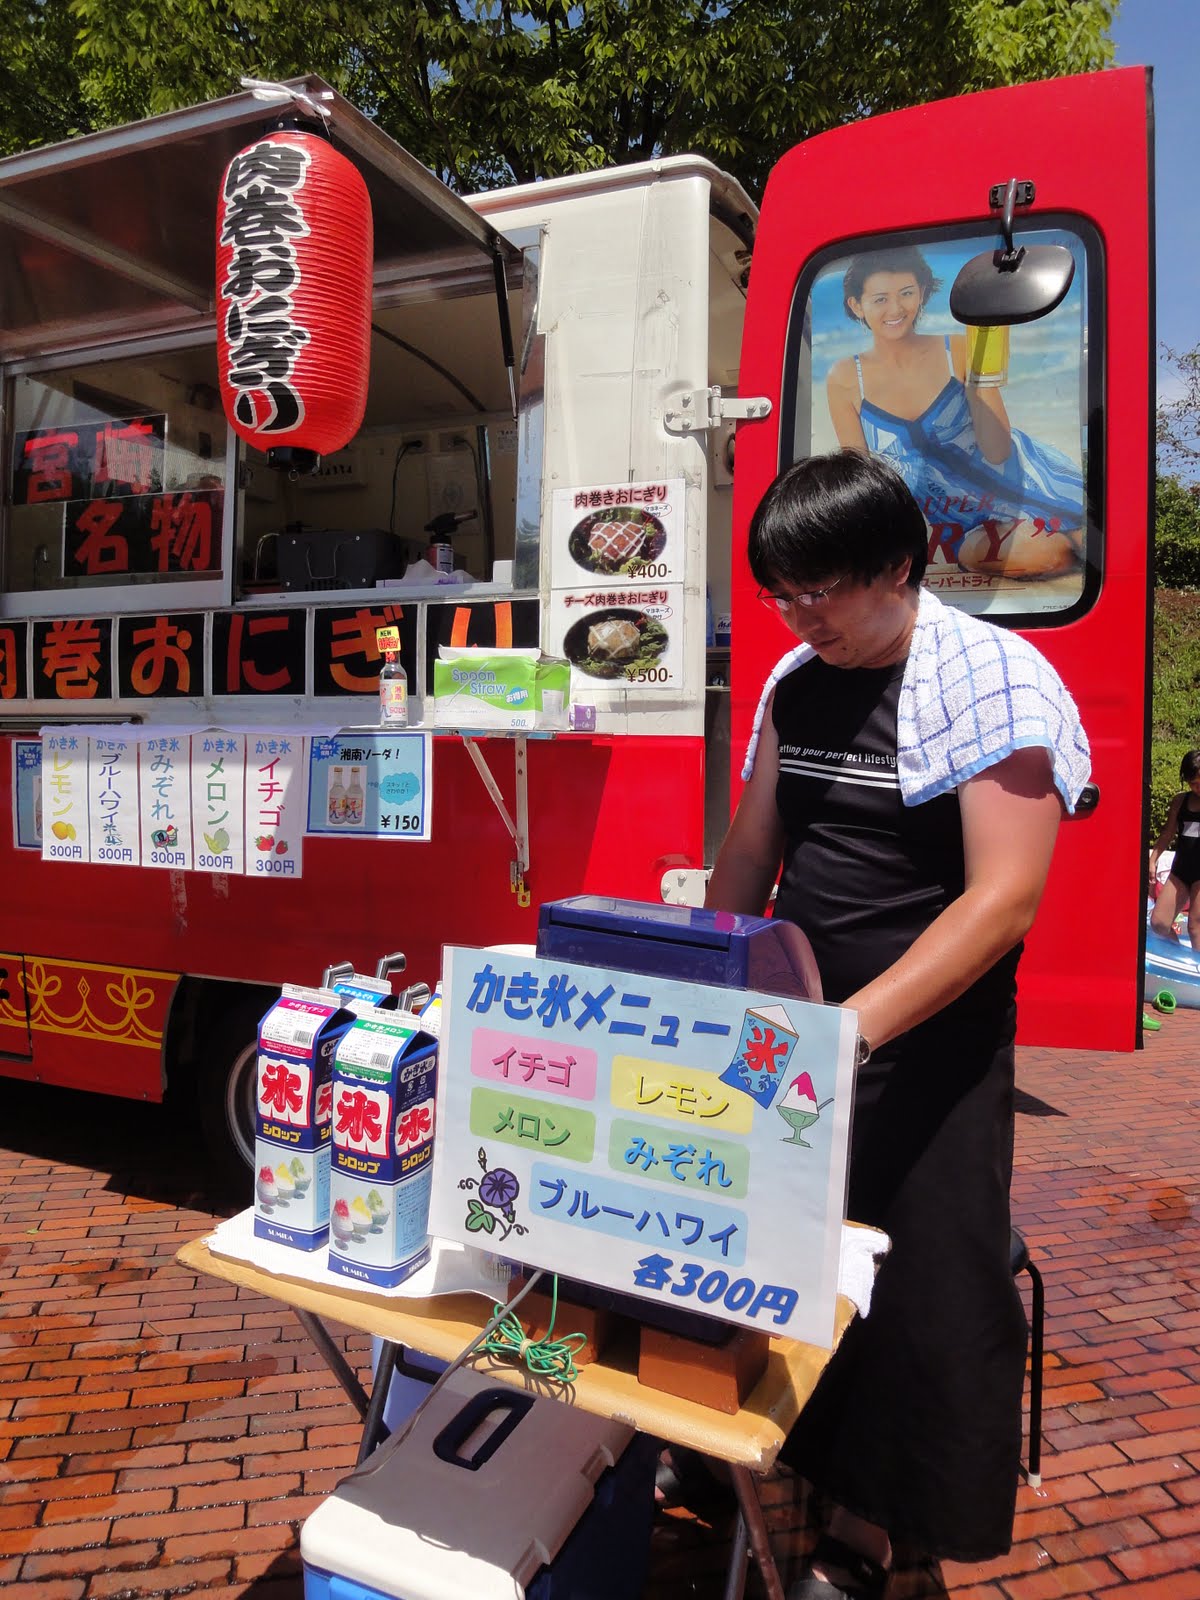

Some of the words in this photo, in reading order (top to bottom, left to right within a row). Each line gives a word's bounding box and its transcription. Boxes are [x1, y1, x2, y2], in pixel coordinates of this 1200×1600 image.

[221, 142, 311, 433] 肉巻おにぎり
[575, 486, 668, 507] 肉巻きおにぎり
[916, 491, 998, 515] UPER
[75, 493, 212, 574] 名物
[565, 590, 668, 608] チーズ肉巻きおにぎり
[453, 669, 495, 683] Spoon
[471, 682, 506, 695] Straw
[49, 737, 78, 750] かき氷
[148, 738, 179, 752] かき氷
[203, 738, 238, 752] かき氷
[256, 740, 291, 754] かき氷
[803, 748, 825, 756] your
[825, 751, 862, 763] perfect
[864, 753, 899, 768] lifesty
[50, 752, 73, 816] レモン
[99, 753, 121, 823] ブルーハワイ
[151, 754, 174, 820] みぞれ
[206, 757, 229, 825] メロン
[258, 757, 285, 827] イチゴ
[50, 845, 82, 858] 300円
[98, 848, 132, 861] 300円
[151, 851, 185, 865] 300円
[199, 855, 233, 869] 300円
[256, 859, 294, 874] 300円
[466, 964, 731, 1047] かき氷メニュー
[742, 1026, 788, 1073] 氷
[491, 1047, 576, 1087] イチゴ
[260, 1064, 303, 1113] 氷
[635, 1076, 730, 1117] レモン
[335, 1090, 382, 1143] 氷
[398, 1107, 431, 1146] 氷
[493, 1107, 571, 1146] メロン
[263, 1123, 301, 1143] シロップ
[338, 1153, 380, 1174] シロップ
[402, 1145, 431, 1171] シロップ
[624, 1137, 733, 1189] みぞれ
[539, 1179, 738, 1256] ブルーハワイ
[268, 1228, 293, 1241] SUMIDA
[342, 1265, 369, 1279] SUMIDA
[633, 1253, 800, 1325] 各300円
